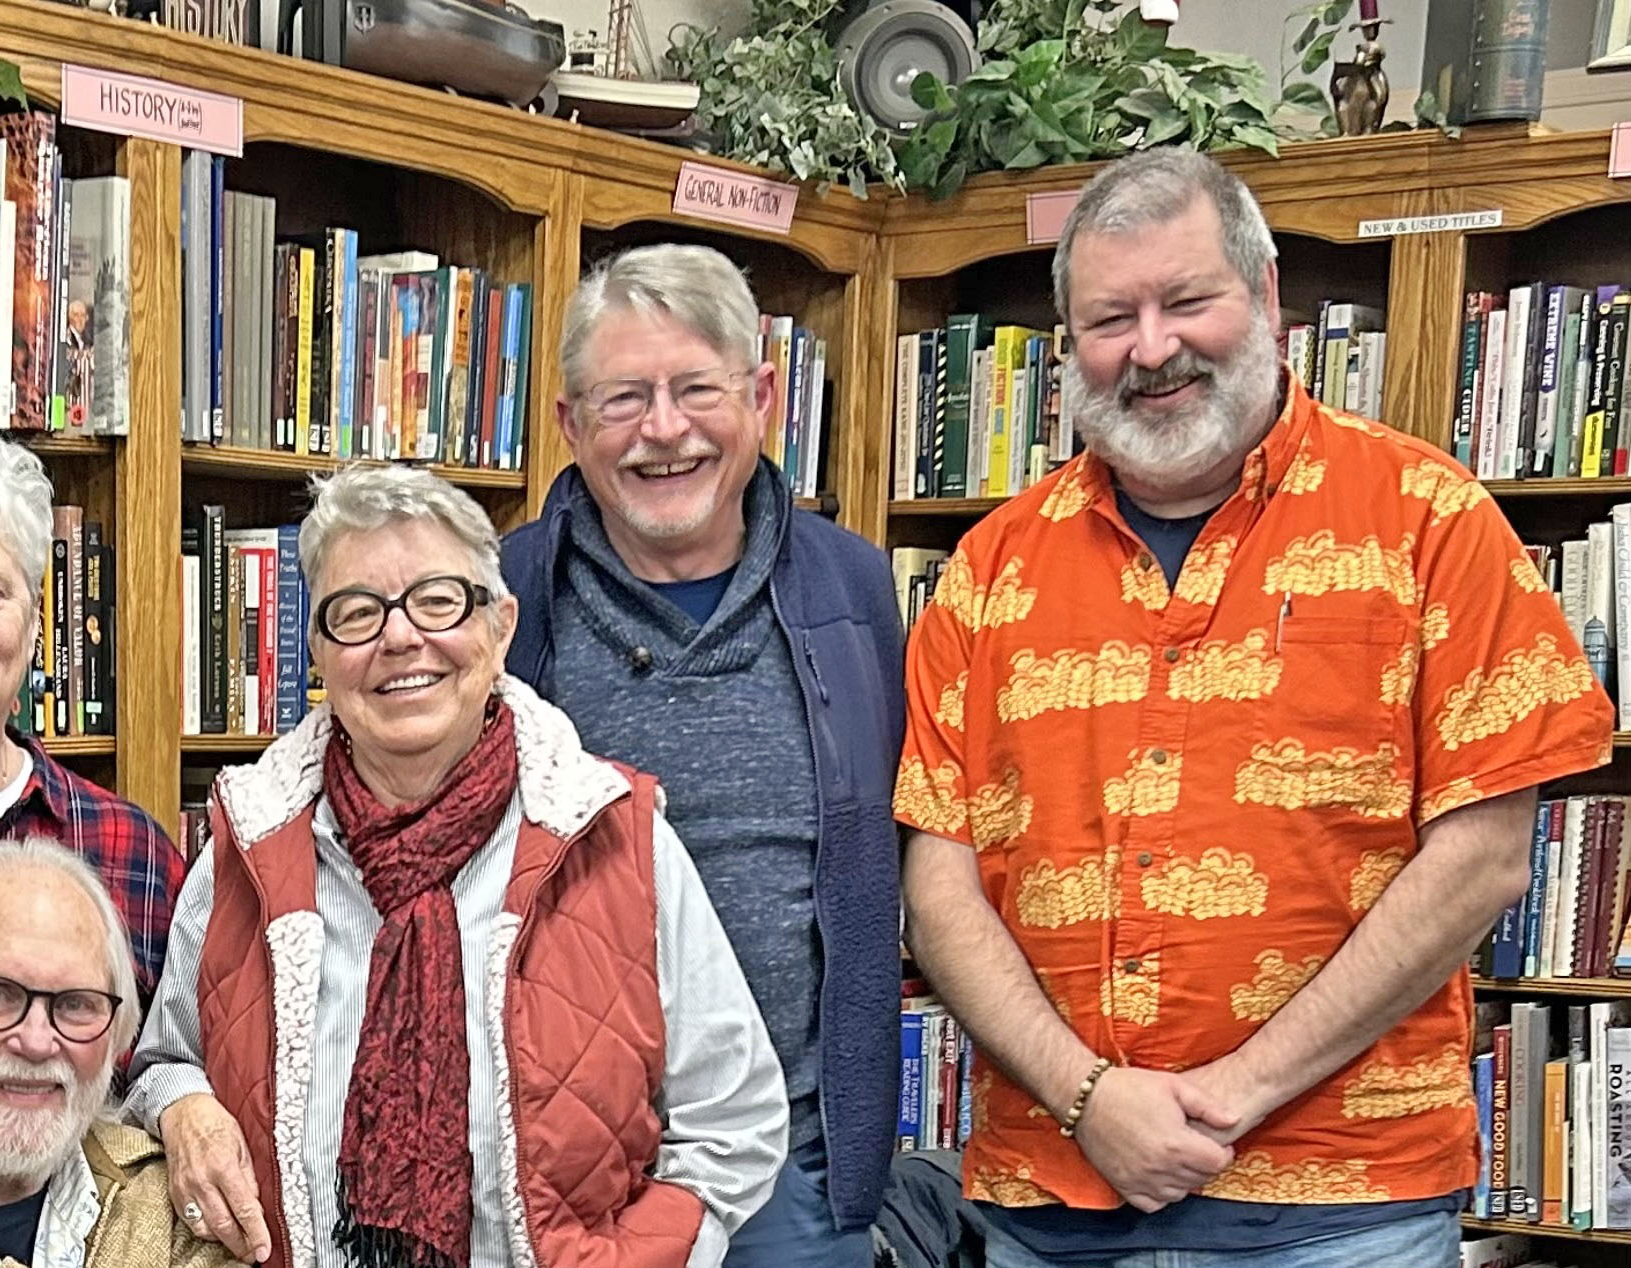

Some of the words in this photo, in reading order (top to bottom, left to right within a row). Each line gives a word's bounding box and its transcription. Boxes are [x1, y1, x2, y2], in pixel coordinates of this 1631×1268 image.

[100, 82, 177, 126] HISTORY
[684, 174, 724, 208] GENERAL
[728, 185, 781, 217] NON-FICTION
[1364, 222, 1394, 235] NEW
[1397, 222, 1406, 232] &
[1411, 218, 1448, 232] USED
[1449, 213, 1497, 229] TITLES
[1544, 292, 1561, 350] EXTREME
[1463, 324, 1476, 387] TASTING
[1541, 353, 1557, 387] WINE
[995, 367, 1008, 405] FICTION
[1591, 362, 1605, 406] Preserving
[1460, 388, 1472, 434] CIDER
[72, 523, 83, 602] ABUNDANCE
[213, 515, 222, 612] THUNDERSTRUCK
[1565, 549, 1580, 592] GOOD
[1617, 547, 1631, 579] Child
[73, 605, 83, 620] OF
[1616, 600, 1630, 651] Company
[73, 625, 84, 667] VALOR
[213, 632, 222, 658] Erik
[213, 660, 222, 699] Larson
[944, 1041, 956, 1064] EXIT
[902, 1058, 911, 1095] READING
[1494, 1079, 1507, 1110] NEW
[1514, 1047, 1525, 1105] COOKING
[901, 1095, 911, 1123] GUIDE
[1609, 1064, 1622, 1158] ROASTING
[1494, 1111, 1506, 1152] GOOD
[1493, 1153, 1505, 1189] FOOD
